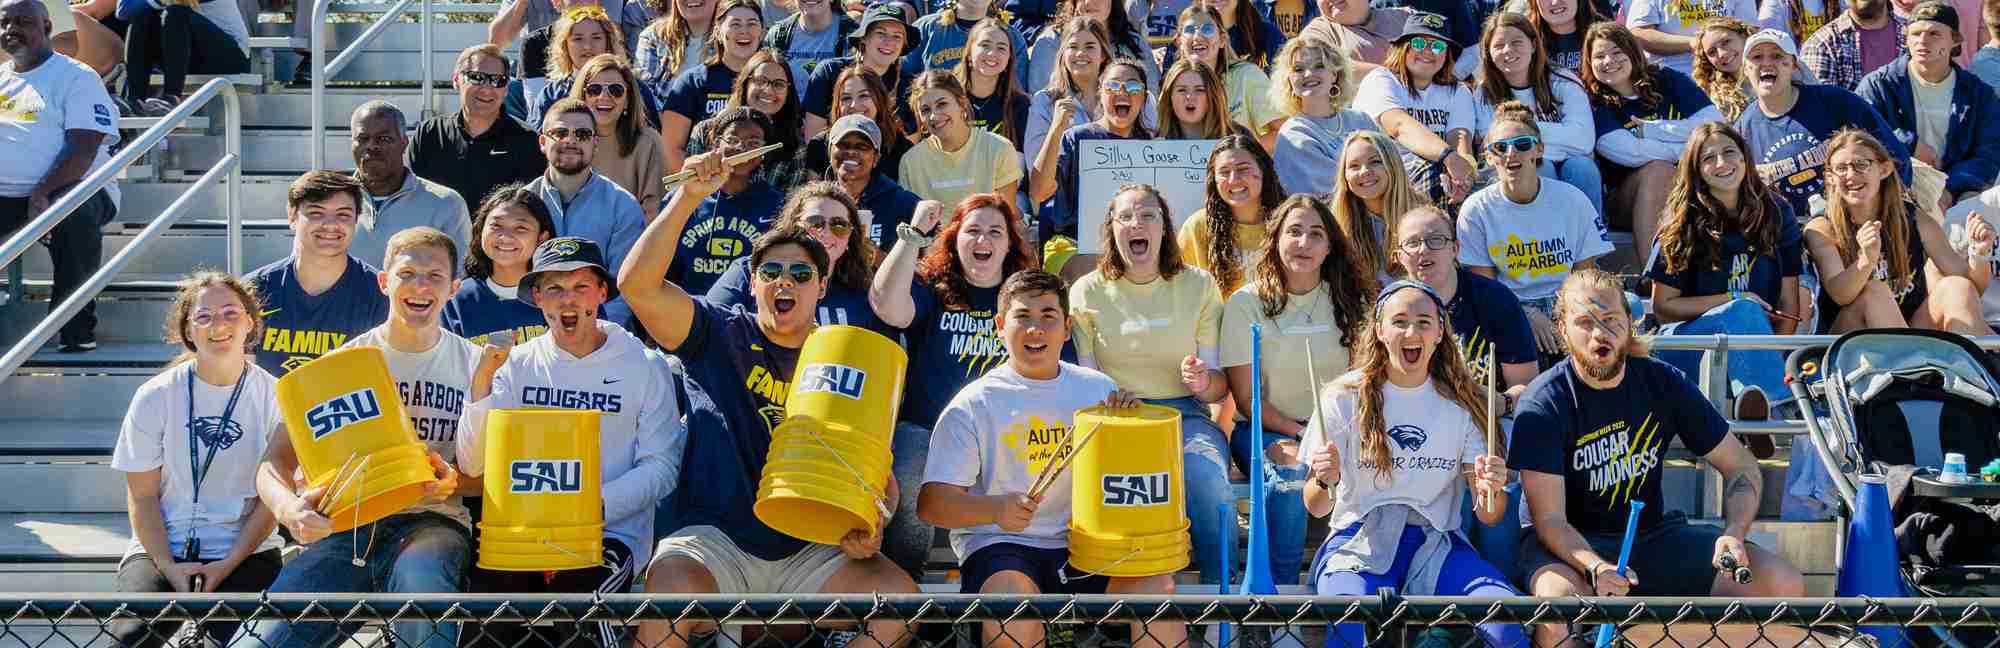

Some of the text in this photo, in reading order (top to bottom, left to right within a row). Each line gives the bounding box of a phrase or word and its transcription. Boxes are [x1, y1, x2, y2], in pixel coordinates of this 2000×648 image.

[1095, 144, 1133, 167] Silly
[1142, 144, 1180, 165] Goose
[1506, 237, 1566, 257] AUTUMN
[1528, 249, 1574, 270] ARBOR
[940, 311, 994, 337] COUGAR
[262, 327, 348, 354] FAMILY
[800, 365, 865, 399] SAU
[412, 380, 465, 415] ARBOR
[521, 386, 622, 413] COUGARS
[307, 389, 380, 439] SAU
[1572, 431, 1630, 471] COUGAR
[511, 462, 580, 492] SAU
[1589, 446, 1659, 492] MADNESS
[1104, 473, 1169, 505] SAU
